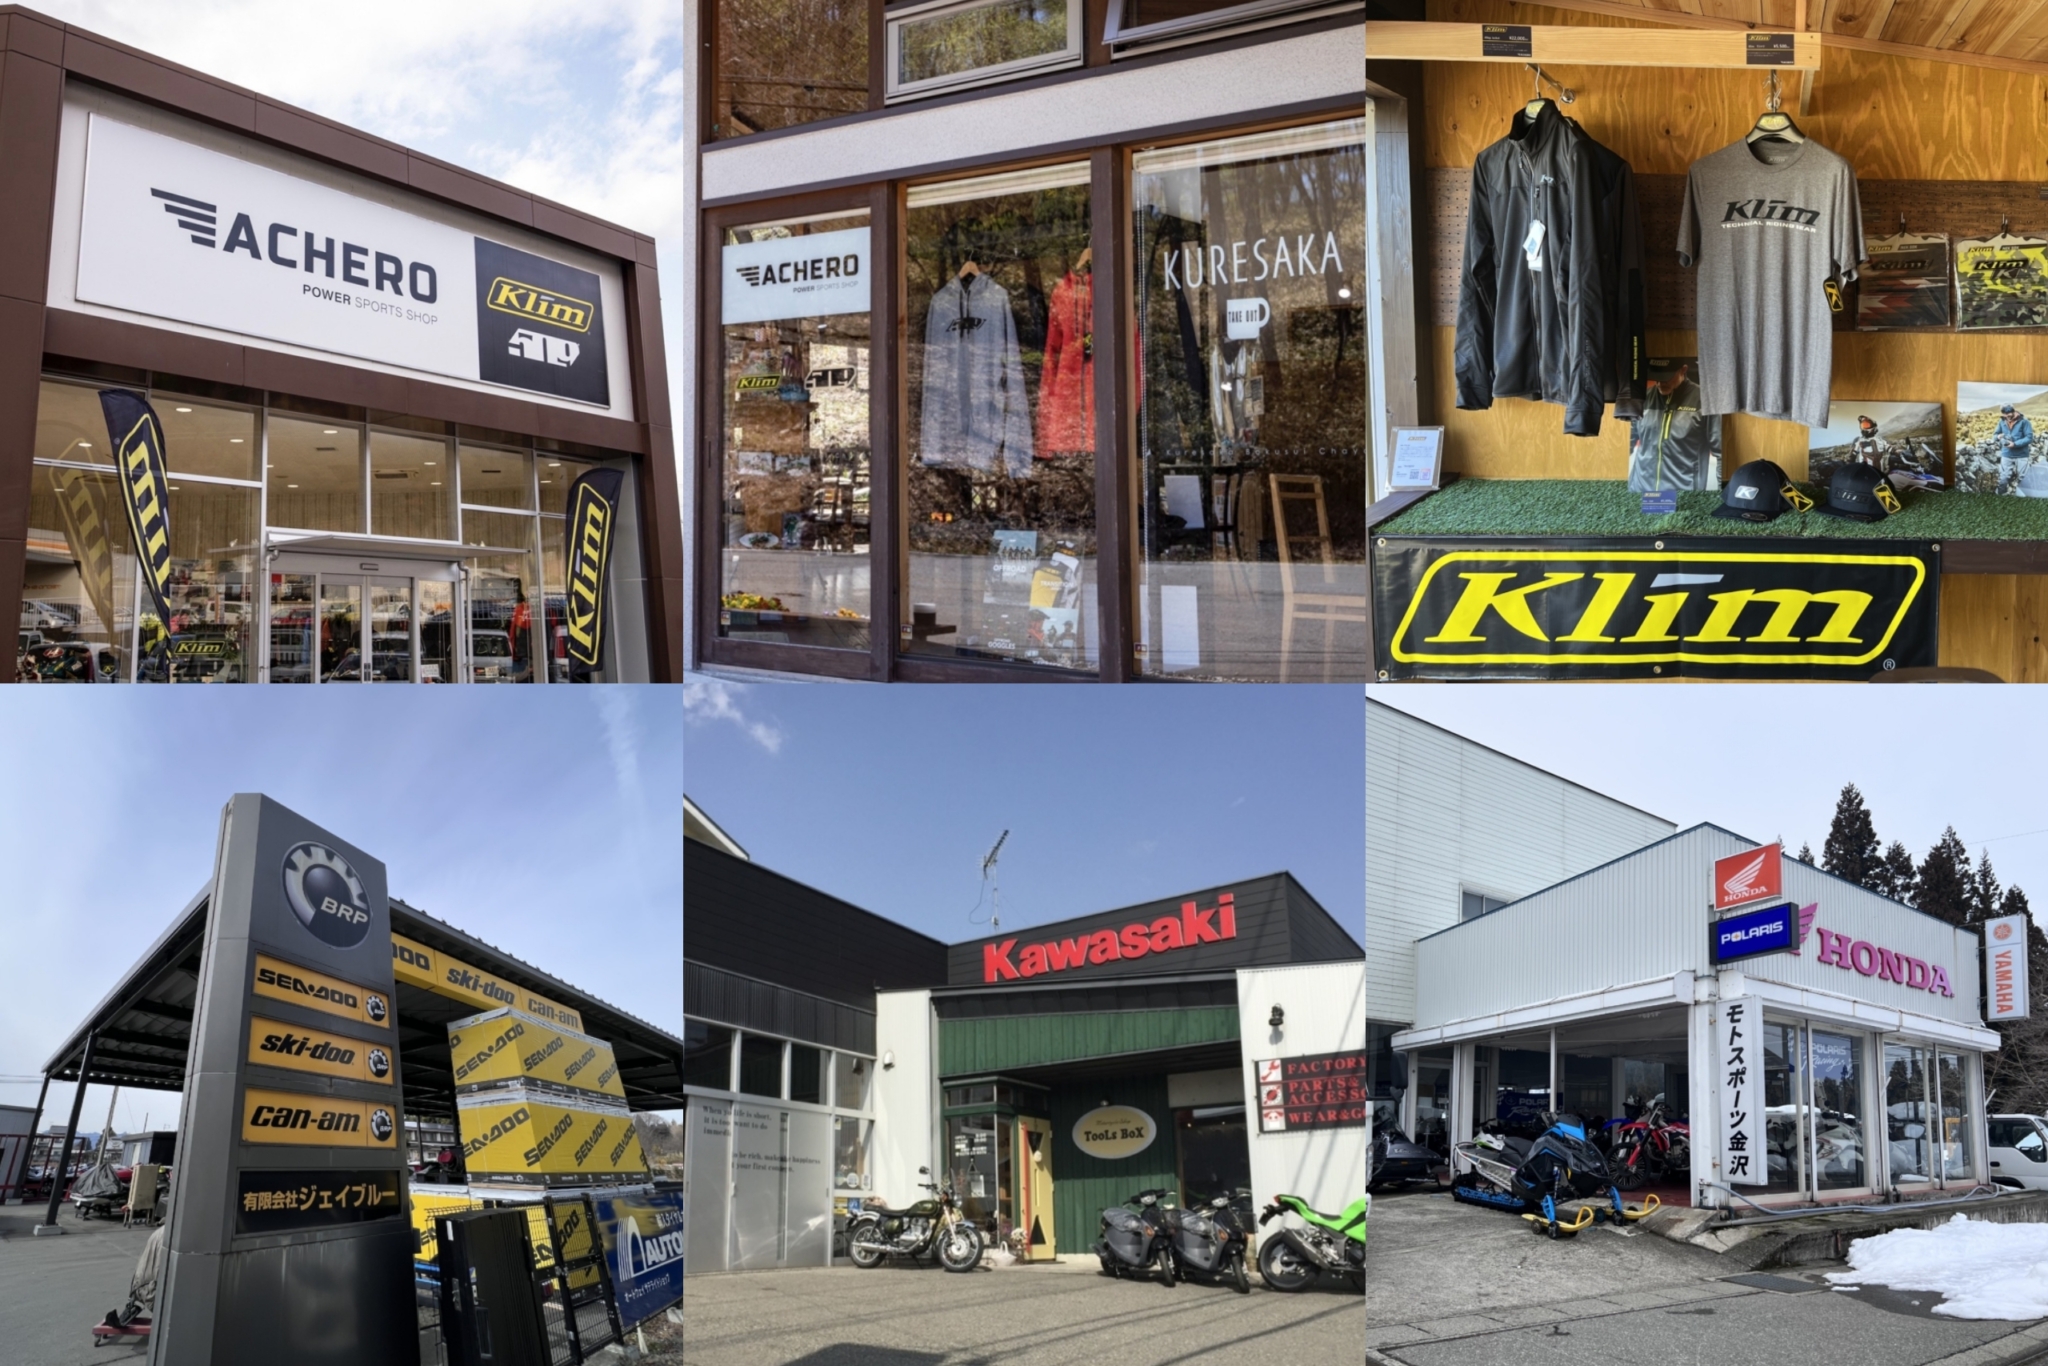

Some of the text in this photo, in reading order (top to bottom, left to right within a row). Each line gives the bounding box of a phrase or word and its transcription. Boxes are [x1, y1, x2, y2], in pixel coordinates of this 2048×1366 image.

[223, 212, 438, 304] ACHERO
[762, 254, 859, 286] ACHERO
[1164, 231, 1343, 291] KURESAKA
[816, 282, 840, 291] SPORTS
[841, 280, 859, 289] SHOP
[303, 284, 438, 326] POWER SPORTS SHOP
[1228, 310, 1258, 324] TAKE OUT
[1724, 885, 1768, 903] HONDA
[320, 896, 369, 925] BRP
[984, 893, 1237, 983] Kawasaki
[1721, 920, 1784, 945] POLARIS
[1816, 927, 1955, 998] HONDA
[446, 967, 515, 1005] ski-doo
[1994, 949, 2014, 1014] YAMAHA
[528, 998, 578, 1028] can-am
[260, 1033, 355, 1065] ski-doo
[1727, 1004, 1749, 1176] モトスポーツ金沢
[251, 1105, 360, 1132] can-am
[1288, 1107, 1366, 1123] WEAR&G
[243, 1183, 395, 1211] 有限会社ジェイブルー
[645, 1230, 684, 1266] AUTO
